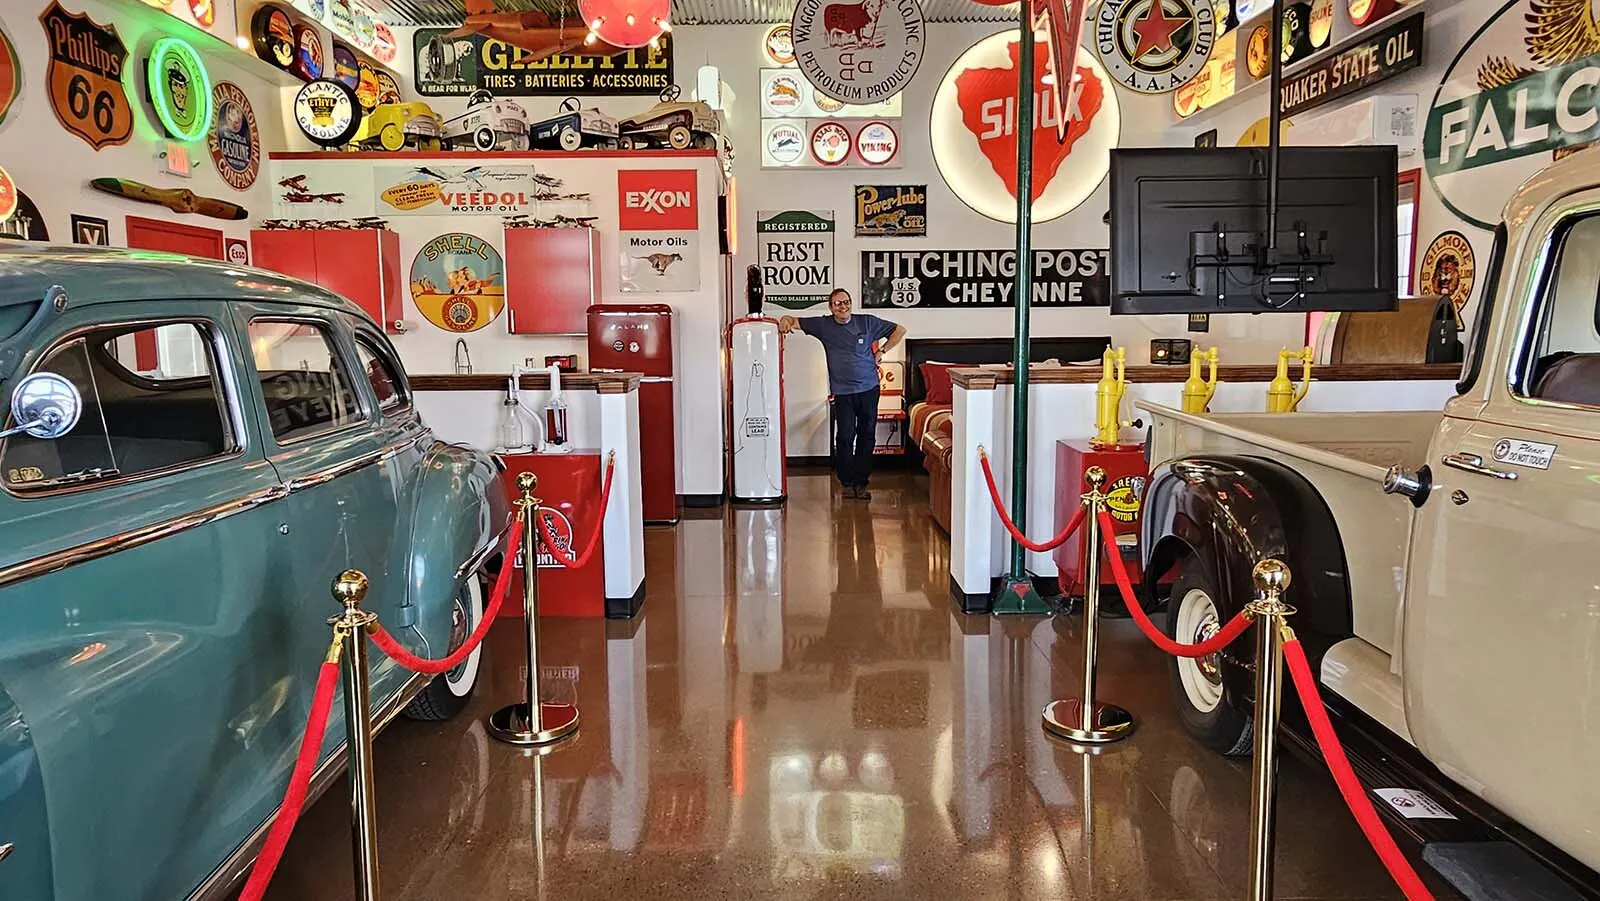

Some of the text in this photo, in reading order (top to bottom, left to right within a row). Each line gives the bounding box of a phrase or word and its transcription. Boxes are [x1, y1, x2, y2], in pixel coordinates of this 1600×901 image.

[794, 0, 825, 44] WAGGO
[1194, 8, 1213, 56] CLUB
[50, 16, 120, 80] Phillips
[481, 38, 668, 70] GILTE
[1332, 44, 1380, 88] STATE
[1385, 30, 1414, 66] OIL
[484, 73, 669, 88] TIRES BATTERIES ACCESSORIES
[802, 50, 917, 99] PETROLEUM PRODUCTS
[299, 83, 348, 106] ATLANTIC
[446, 84, 459, 92] FOR
[68, 74, 118, 134] 66
[310, 99, 336, 107] ETHYL
[981, 82, 1083, 141] SIUX
[1440, 65, 1600, 165] FALC
[300, 116, 350, 138] GASOLINE
[861, 141, 893, 153] VIKING
[218, 158, 256, 188] COMPANY
[407, 183, 419, 192] 60
[441, 192, 529, 206] VEEDOL
[625, 189, 690, 213] EXXON
[764, 223, 829, 231] REGISTERED
[903, 219, 925, 228] OIL
[424, 236, 488, 262] SHELL
[630, 237, 688, 247] Motor Oils
[767, 242, 824, 262] REST
[1426, 235, 1471, 266] GILMORE
[763, 265, 830, 285] ROOM
[869, 251, 1108, 278] HITCHING POST
[896, 281, 916, 290] U.S.
[946, 282, 1084, 303] CHEYNNE
[895, 291, 917, 305] 30
[1519, 443, 1545, 455] Please
[1531, 455, 1549, 466] TOUCH
